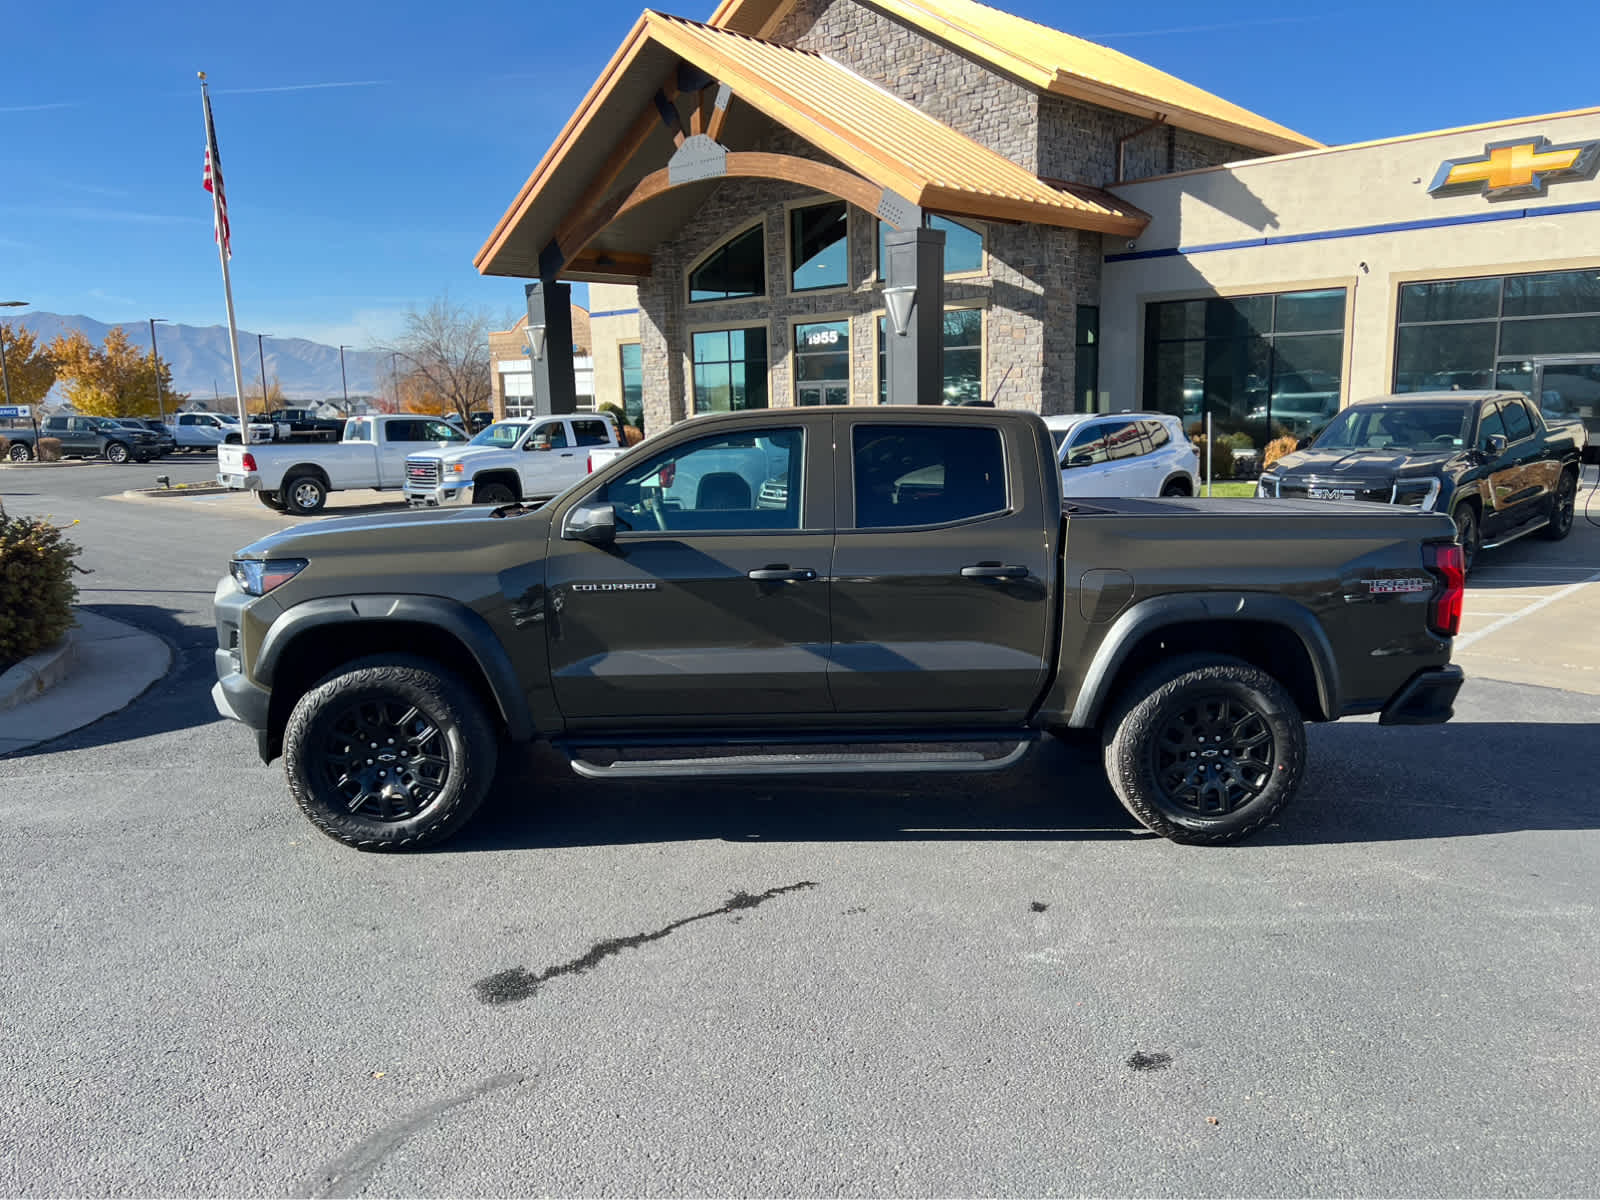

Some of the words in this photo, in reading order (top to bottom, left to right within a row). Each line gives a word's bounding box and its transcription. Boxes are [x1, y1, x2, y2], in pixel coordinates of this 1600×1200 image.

[807, 330, 838, 345] 1955
[1307, 488, 1355, 500] GMC
[572, 583, 657, 591] COLORADO
